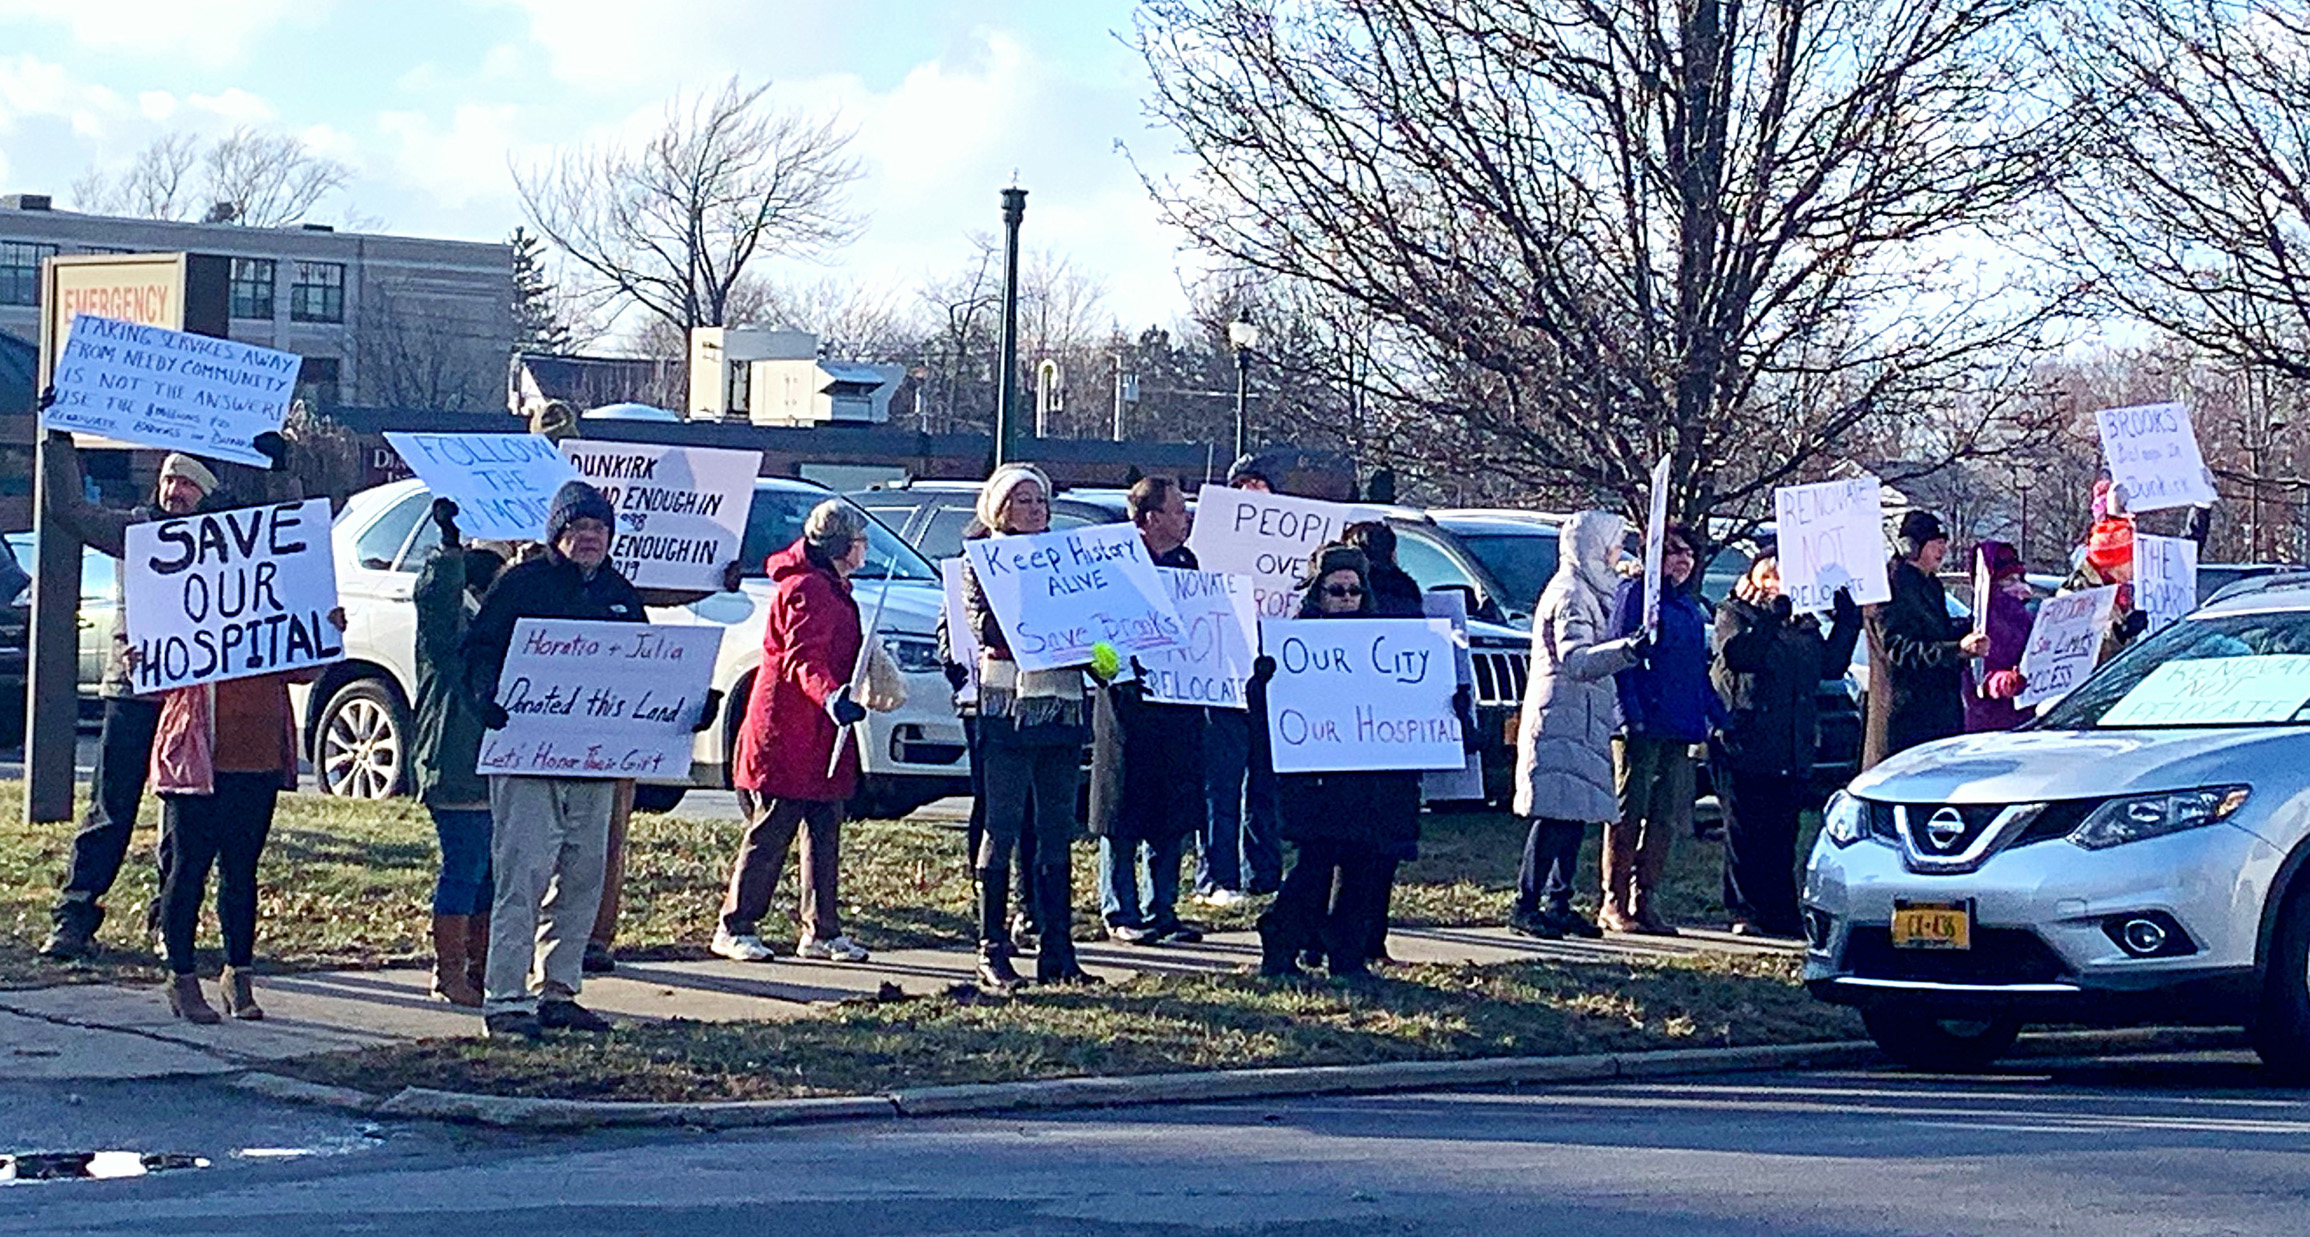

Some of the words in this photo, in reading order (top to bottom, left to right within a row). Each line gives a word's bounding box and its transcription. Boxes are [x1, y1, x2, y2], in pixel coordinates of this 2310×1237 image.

[64, 285, 168, 325] EMERGENCY
[65, 339, 116, 363] FROM
[123, 349, 177, 372] NEEDY
[181, 360, 287, 391] COMMUNITY
[242, 350, 293, 373] AWAY
[64, 367, 84, 383] IS
[99, 372, 145, 390] NOT
[154, 381, 184, 400] THE
[54, 389, 94, 406] USE
[106, 396, 137, 414] THE
[2105, 408, 2178, 439] BROOKS
[413, 435, 556, 466] FOLLOW
[472, 470, 538, 492] THE
[571, 454, 658, 480] DUNKIRK
[622, 486, 695, 515] ENOUGH
[696, 493, 723, 516] IN
[149, 503, 306, 575] SAVE
[1234, 503, 1332, 544] PEOPL
[613, 535, 691, 562] ENOUGH
[692, 540, 718, 565] IN
[981, 543, 1061, 577] Keep
[1066, 535, 1140, 567] History
[1802, 526, 1846, 578] NOT
[2138, 538, 2172, 579] THE
[1048, 570, 1108, 597] ALIVE
[1256, 554, 1308, 582] OVE
[184, 562, 284, 623] OUR
[1158, 568, 1237, 600] NOVATE
[141, 611, 341, 687] HOSPITAL
[522, 629, 599, 657] Horatio
[625, 633, 683, 660] Julia
[1016, 622, 1095, 654] Save
[2166, 658, 2310, 682] RENOVAT
[503, 677, 582, 716] Donated
[587, 686, 626, 717] this
[632, 690, 685, 723] Land
[2174, 676, 2256, 698] NOT
